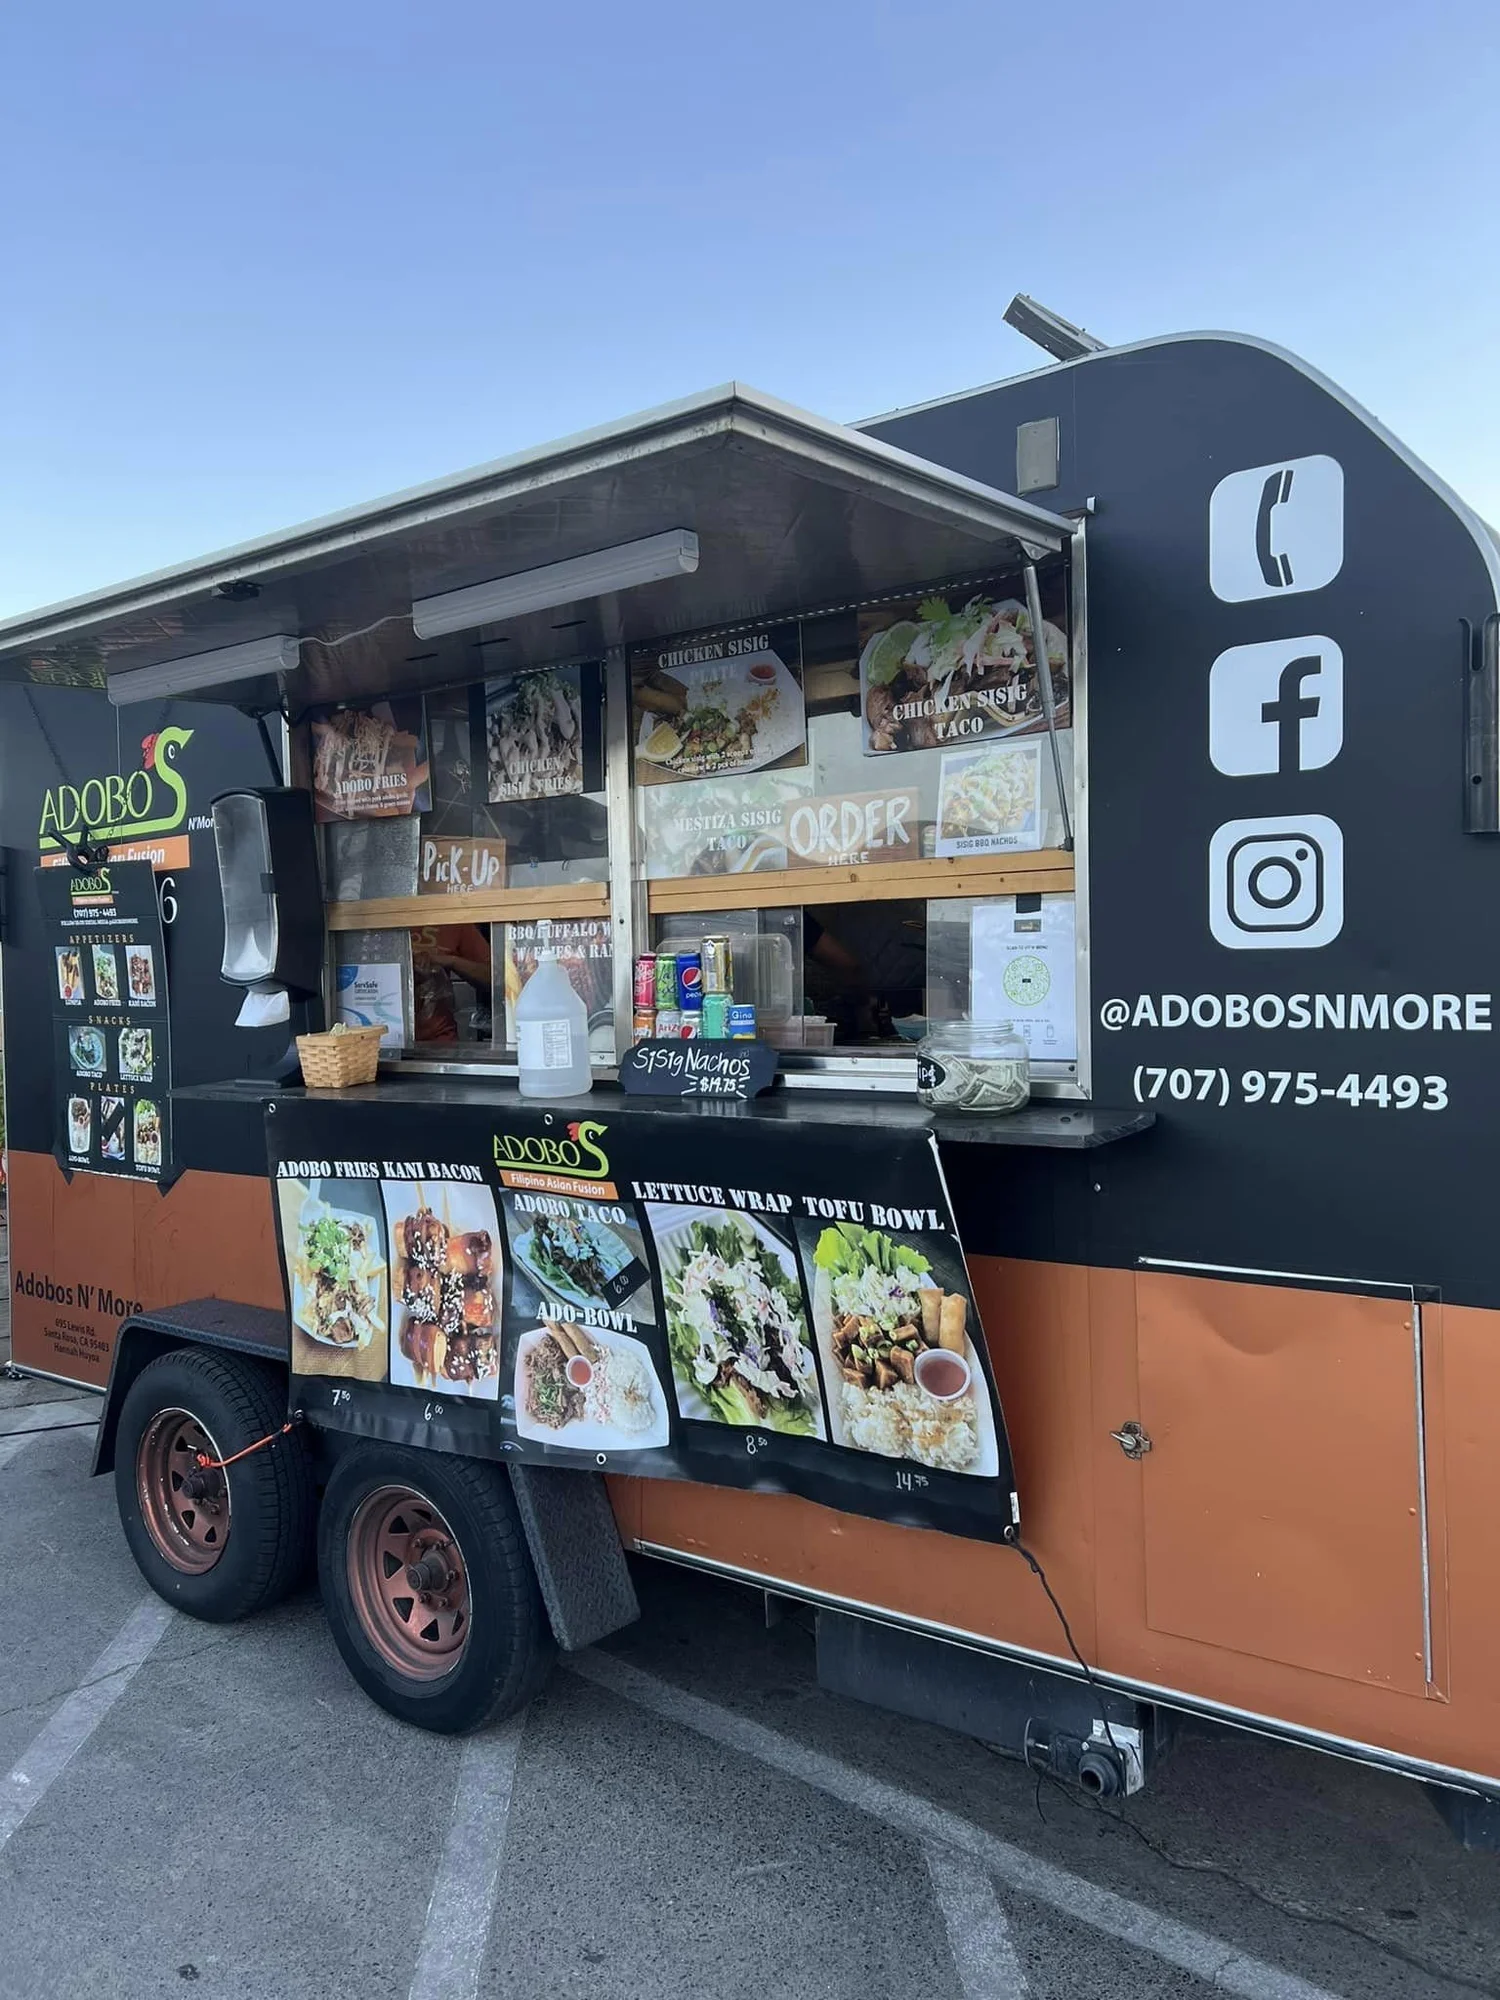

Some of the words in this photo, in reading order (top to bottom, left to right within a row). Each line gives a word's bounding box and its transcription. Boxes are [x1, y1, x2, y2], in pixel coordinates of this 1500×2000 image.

[658, 642, 723, 668] CHICKEN
[728, 634, 770, 656] SISIG
[892, 693, 971, 721] CHICKEN
[977, 684, 1027, 708] SISIG
[934, 717, 984, 740] TACO
[509, 757, 561, 775] CHICKEN
[336, 778, 372, 794] ADOBO
[374, 773, 407, 792] FRIES
[741, 810, 782, 827] SISIG
[790, 796, 911, 857] ORDER
[707, 835, 746, 852] TACO
[956, 840, 974, 849] SISIG
[975, 838, 989, 848] BBQ
[828, 852, 870, 867] HERE
[446, 883, 474, 894] HERE
[70, 934, 135, 944] APPETIZERS
[354, 980, 378, 989] ServSafe
[88, 1015, 131, 1025] SNACKS
[732, 1010, 752, 1020] Gina
[1100, 993, 1492, 1031] @ADOBOSNMORE
[684, 1047, 750, 1076] Nachos
[90, 1082, 135, 1094] PLATES
[1133, 1065, 1230, 1106] (707)
[1241, 1070, 1449, 1111] 975-4493
[276, 1161, 331, 1178] ADOBO
[333, 1161, 379, 1178] FRIES
[382, 1161, 425, 1178] KANI
[427, 1162, 483, 1182] BACON
[511, 1174, 545, 1188] Filipino
[546, 1177, 572, 1191] Asian
[573, 1182, 605, 1195] Fusion
[631, 1181, 725, 1205] LETTUCE
[729, 1188, 793, 1214] WRAP
[514, 1194, 570, 1218] ADOBO
[573, 1202, 626, 1225] TACO
[802, 1196, 865, 1222] TOFU
[871, 1204, 945, 1230] BOWL
[15, 1271, 73, 1306] Adobos
[98, 1288, 143, 1318] More
[536, 1302, 638, 1333] ADO-BOWL
[79, 1336, 89, 1347] CA
